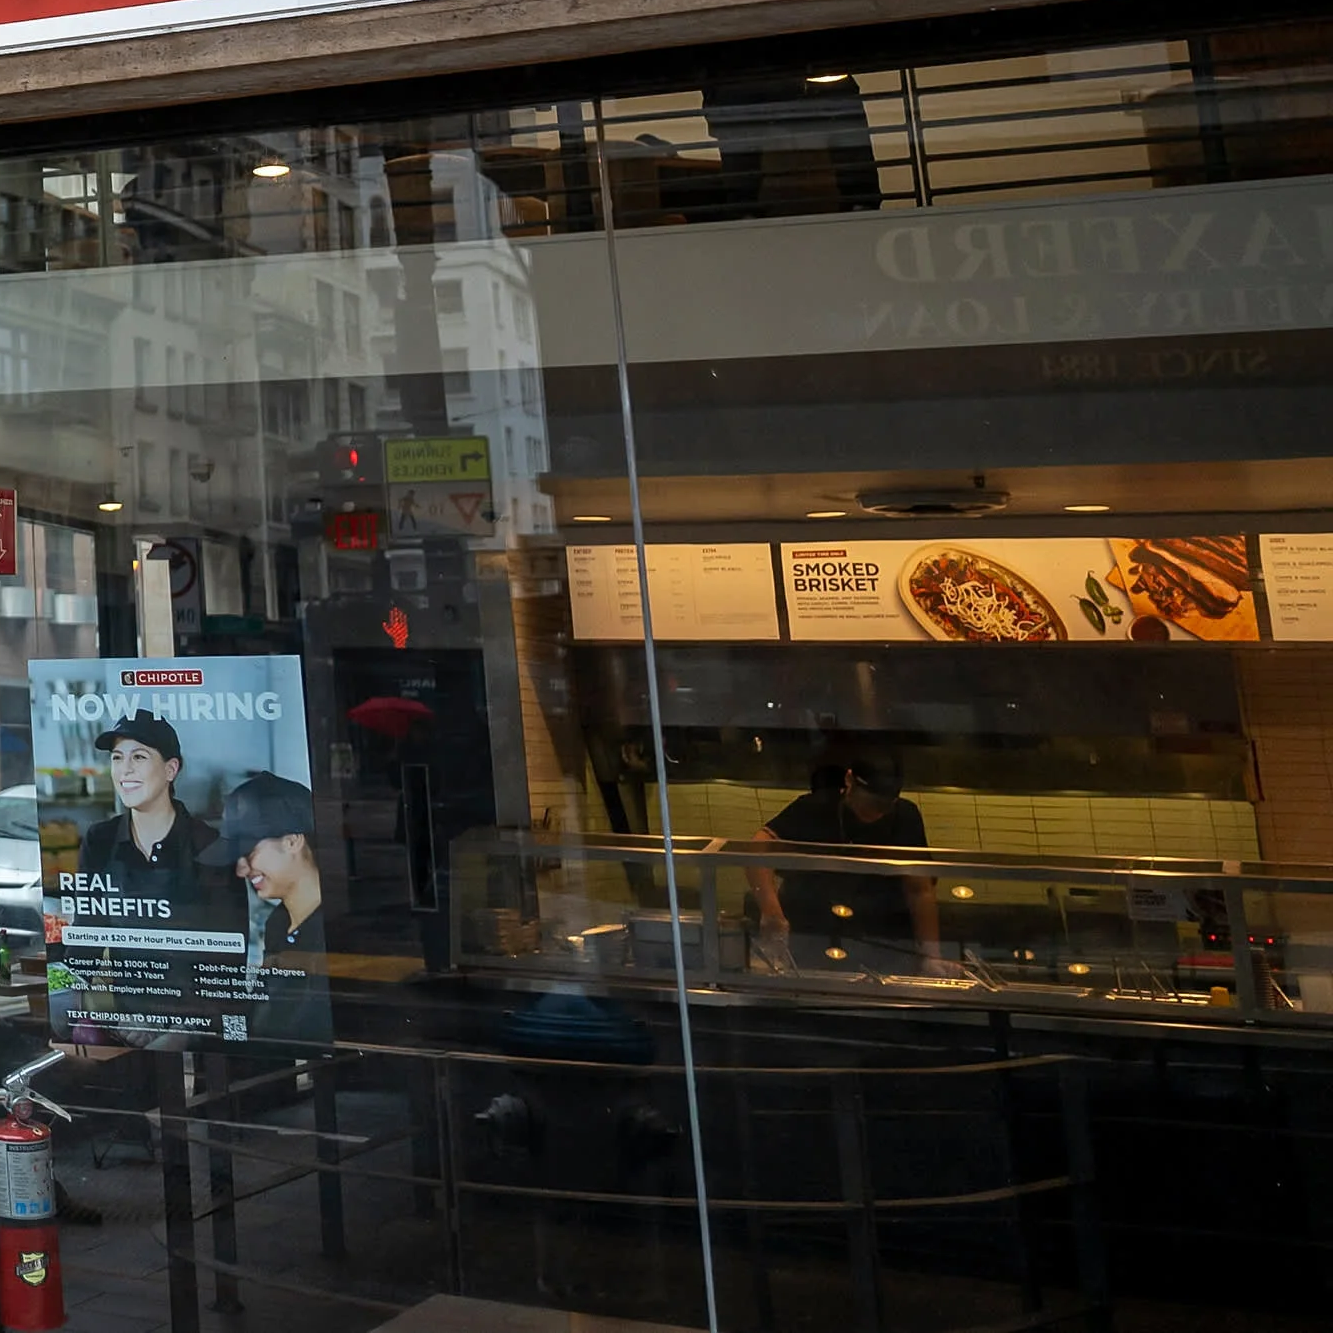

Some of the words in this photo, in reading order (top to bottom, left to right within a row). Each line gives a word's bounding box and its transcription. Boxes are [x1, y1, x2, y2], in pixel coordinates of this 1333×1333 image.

[335, 514, 379, 550] EXIT
[793, 562, 879, 576] SMOKED
[794, 578, 879, 592] BRISKET
[138, 672, 200, 683] CHIPOTLE
[51, 693, 140, 721] NOW
[152, 692, 282, 721] HIRING
[58, 872, 119, 892] REAL
[60, 896, 171, 918] BENEFITS
[67, 932, 99, 942] Starting
[111, 933, 126, 942] $20
[129, 934, 142, 942] Per
[144, 935, 164, 944] Hour
[166, 937, 182, 945] Plus
[185, 937, 204, 946] Cash
[207, 938, 242, 947] Bonuses
[69, 957, 94, 965] Career
[95, 958, 112, 967] Path
[124, 960, 149, 969] $100K
[150, 961, 169, 969] Total
[69, 968, 123, 978] Compensation
[124, 970, 132, 978] in
[143, 971, 165, 980] Years
[198, 964, 239, 973] Debt-Free
[240, 965, 271, 976] College
[272, 967, 306, 977] Degrees
[199, 977, 230, 986] Medical
[232, 978, 265, 988] Benefits
[90, 984, 108, 992] with
[109, 985, 145, 995] Employer
[146, 986, 182, 997] Matching
[200, 989, 232, 999] Flexible
[233, 991, 270, 1001] Schedule
[66, 1010, 88, 1019] TEXT
[89, 1011, 131, 1022] CHIPJOBS
[132, 1013, 145, 1022] TO
[147, 1015, 168, 1024] 97211
[170, 1016, 182, 1025] TO
[183, 1017, 212, 1027] APPLY
